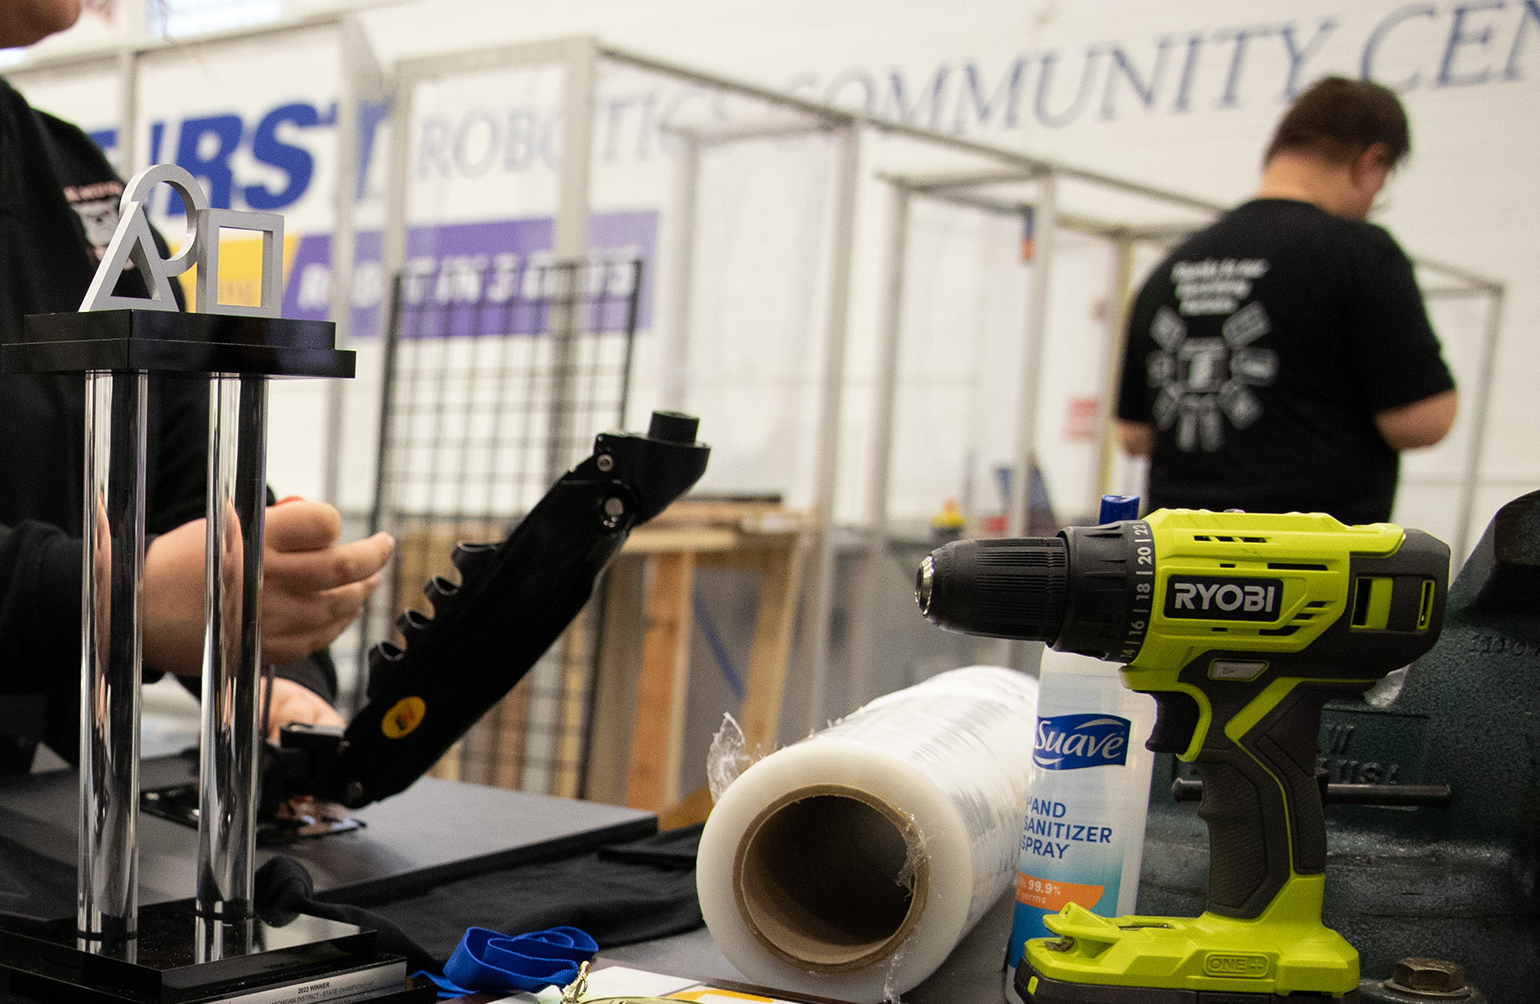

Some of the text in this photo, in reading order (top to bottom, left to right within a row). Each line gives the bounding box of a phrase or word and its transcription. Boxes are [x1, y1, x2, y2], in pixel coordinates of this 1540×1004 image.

[88, 98, 398, 216] IRST
[1132, 523, 1149, 536] 22
[1137, 546, 1152, 565] 20
[1135, 582, 1151, 600] 18
[1174, 583, 1275, 612] RYOBI
[1128, 620, 1145, 636] 16
[1034, 720, 1124, 759] Suave
[1026, 795, 1067, 819] HAND
[1024, 815, 1113, 844] SANITIZER
[1021, 835, 1070, 860] SPRAY
[1028, 879, 1061, 895] 99.9%
[296, 993, 320, 1003] DISTRICT
[322, 988, 338, 998] STATE
[309, 982, 330, 992] WINNER
